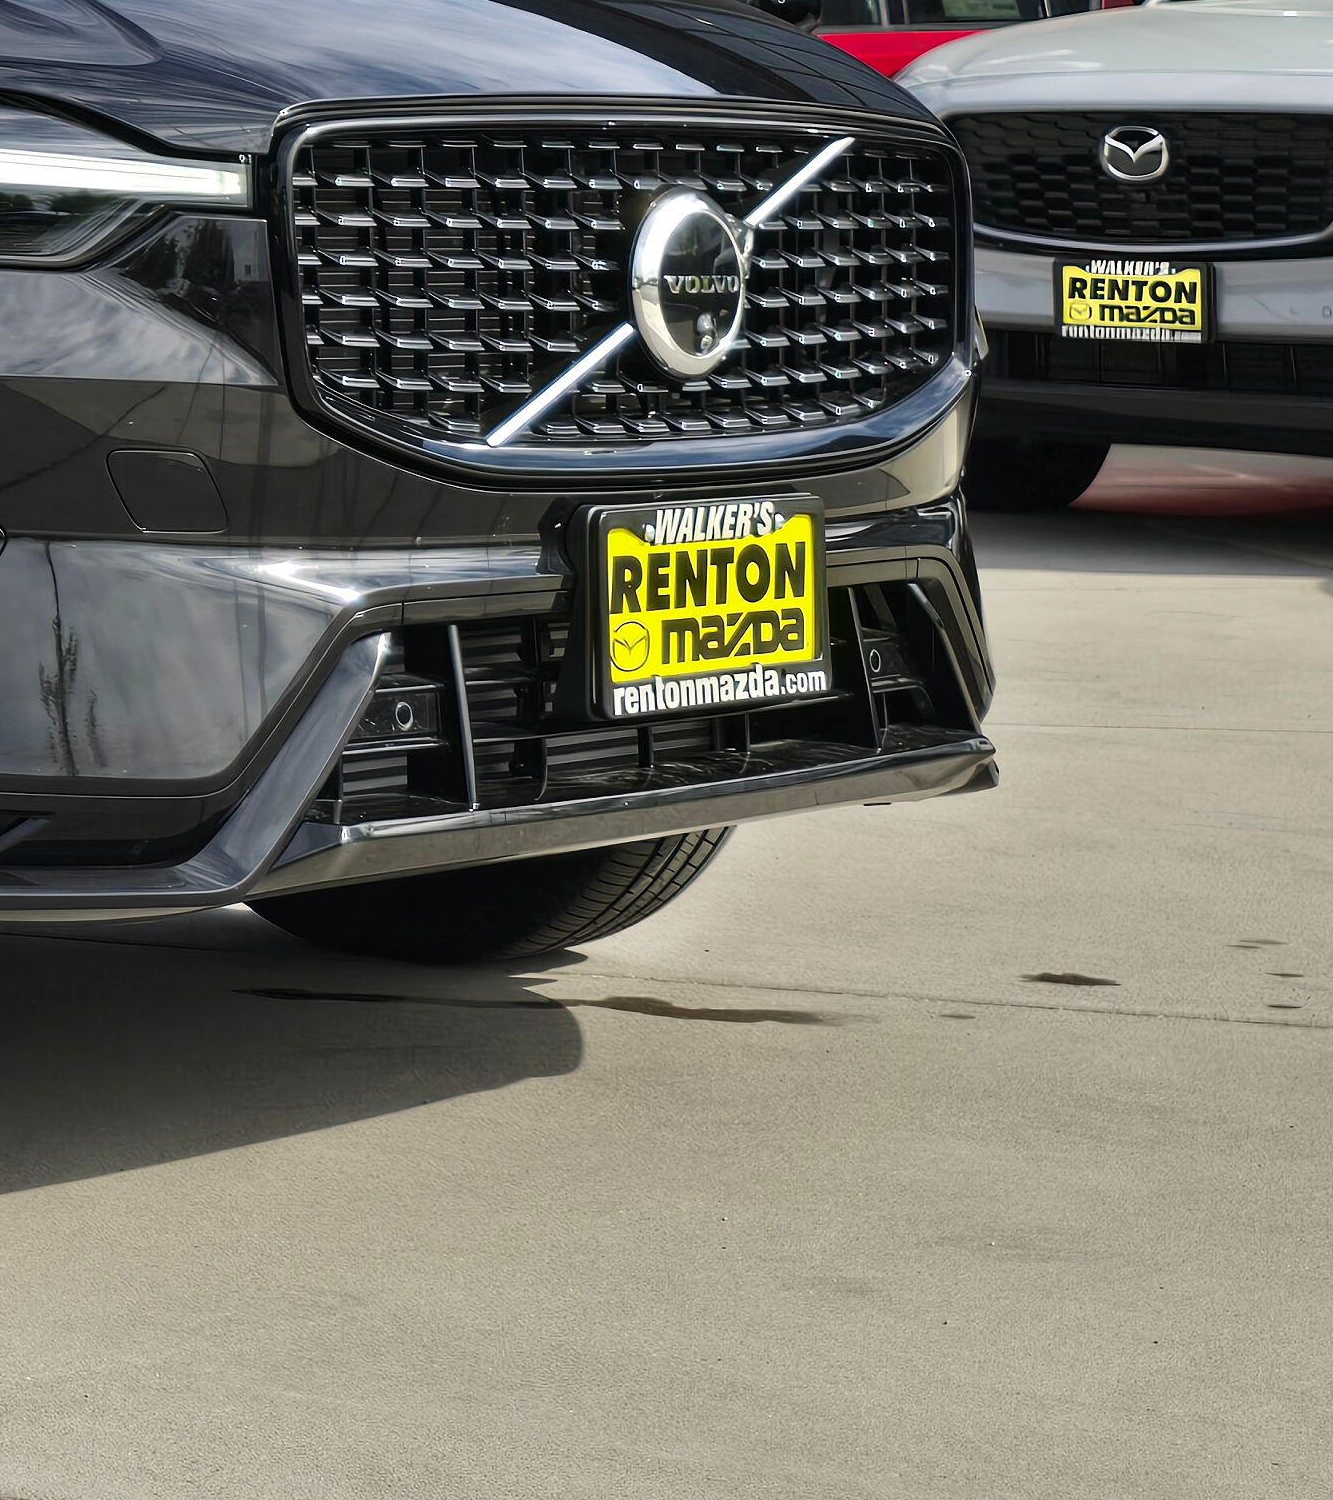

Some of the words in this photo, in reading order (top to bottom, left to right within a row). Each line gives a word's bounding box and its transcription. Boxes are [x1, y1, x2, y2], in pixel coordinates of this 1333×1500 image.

[663, 274, 740, 295] VOLVO
[1068, 276, 1198, 304] RENTON
[653, 501, 775, 545] WALKER'S
[610, 541, 806, 614] RENTON
[613, 663, 827, 716] rentonmazda.com
